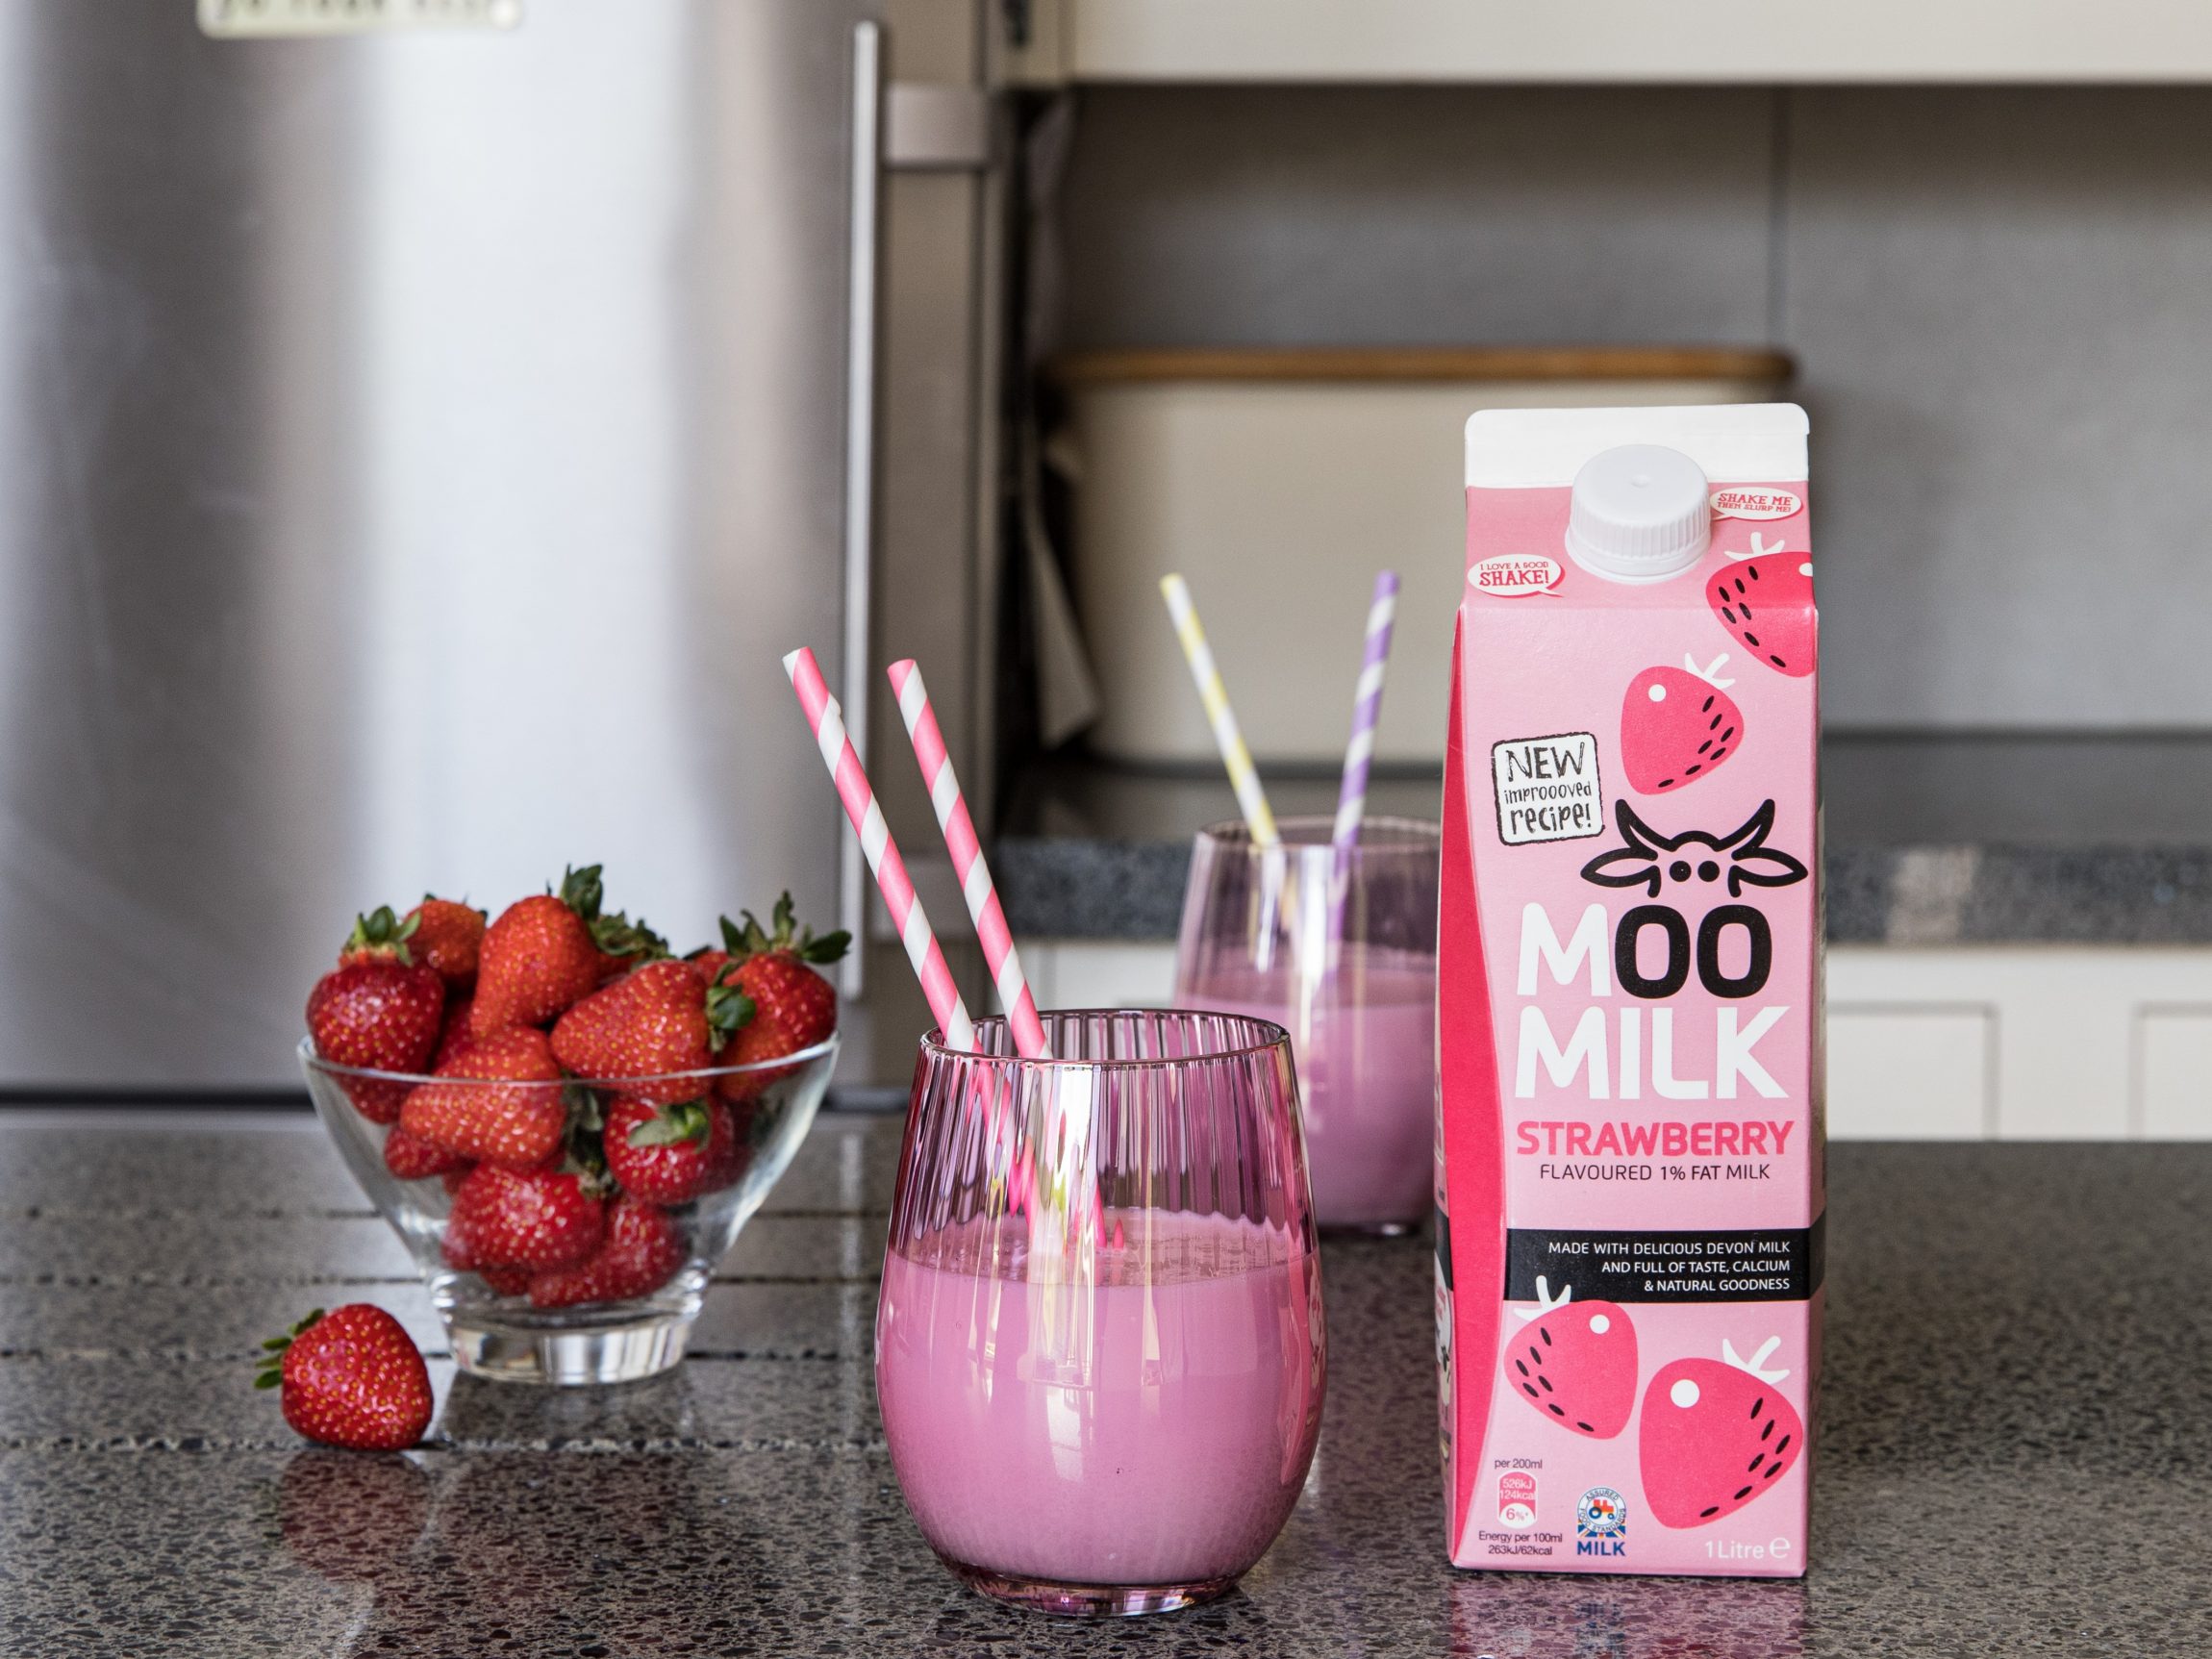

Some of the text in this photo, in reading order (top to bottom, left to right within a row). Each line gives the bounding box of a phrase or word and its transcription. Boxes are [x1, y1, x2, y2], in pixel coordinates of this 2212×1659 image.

[1718, 493, 1793, 506] SHAKE ME
[1479, 570, 1549, 587] SHAKE!
[1505, 742, 1585, 782] NEW
[1504, 781, 1592, 805] improooved
[1510, 803, 1592, 835] recipe!
[1517, 902, 1772, 999] MOO
[1515, 1005, 1791, 1099] MILK
[1516, 1120, 1795, 1157] STRAWBERRY
[1540, 1164, 1771, 1181] FLAVOURED 1% FAT MILK
[1548, 1242, 1791, 1255] MADE WITH DELICIOUS DEVON MILK
[1601, 1260, 1791, 1274] AND FULL OF TASTE, CALCIUM
[1644, 1278, 1790, 1292] & NATURAL GOODNESS
[1495, 1458, 1543, 1470] per 200ml
[1478, 1530, 1563, 1544] Energy per 100ml
[1488, 1545, 1553, 1556] 263kJ/62kcal
[1577, 1541, 1625, 1556] MILK
[1705, 1540, 1713, 1558] 1
[1718, 1540, 1765, 1559] Litre
